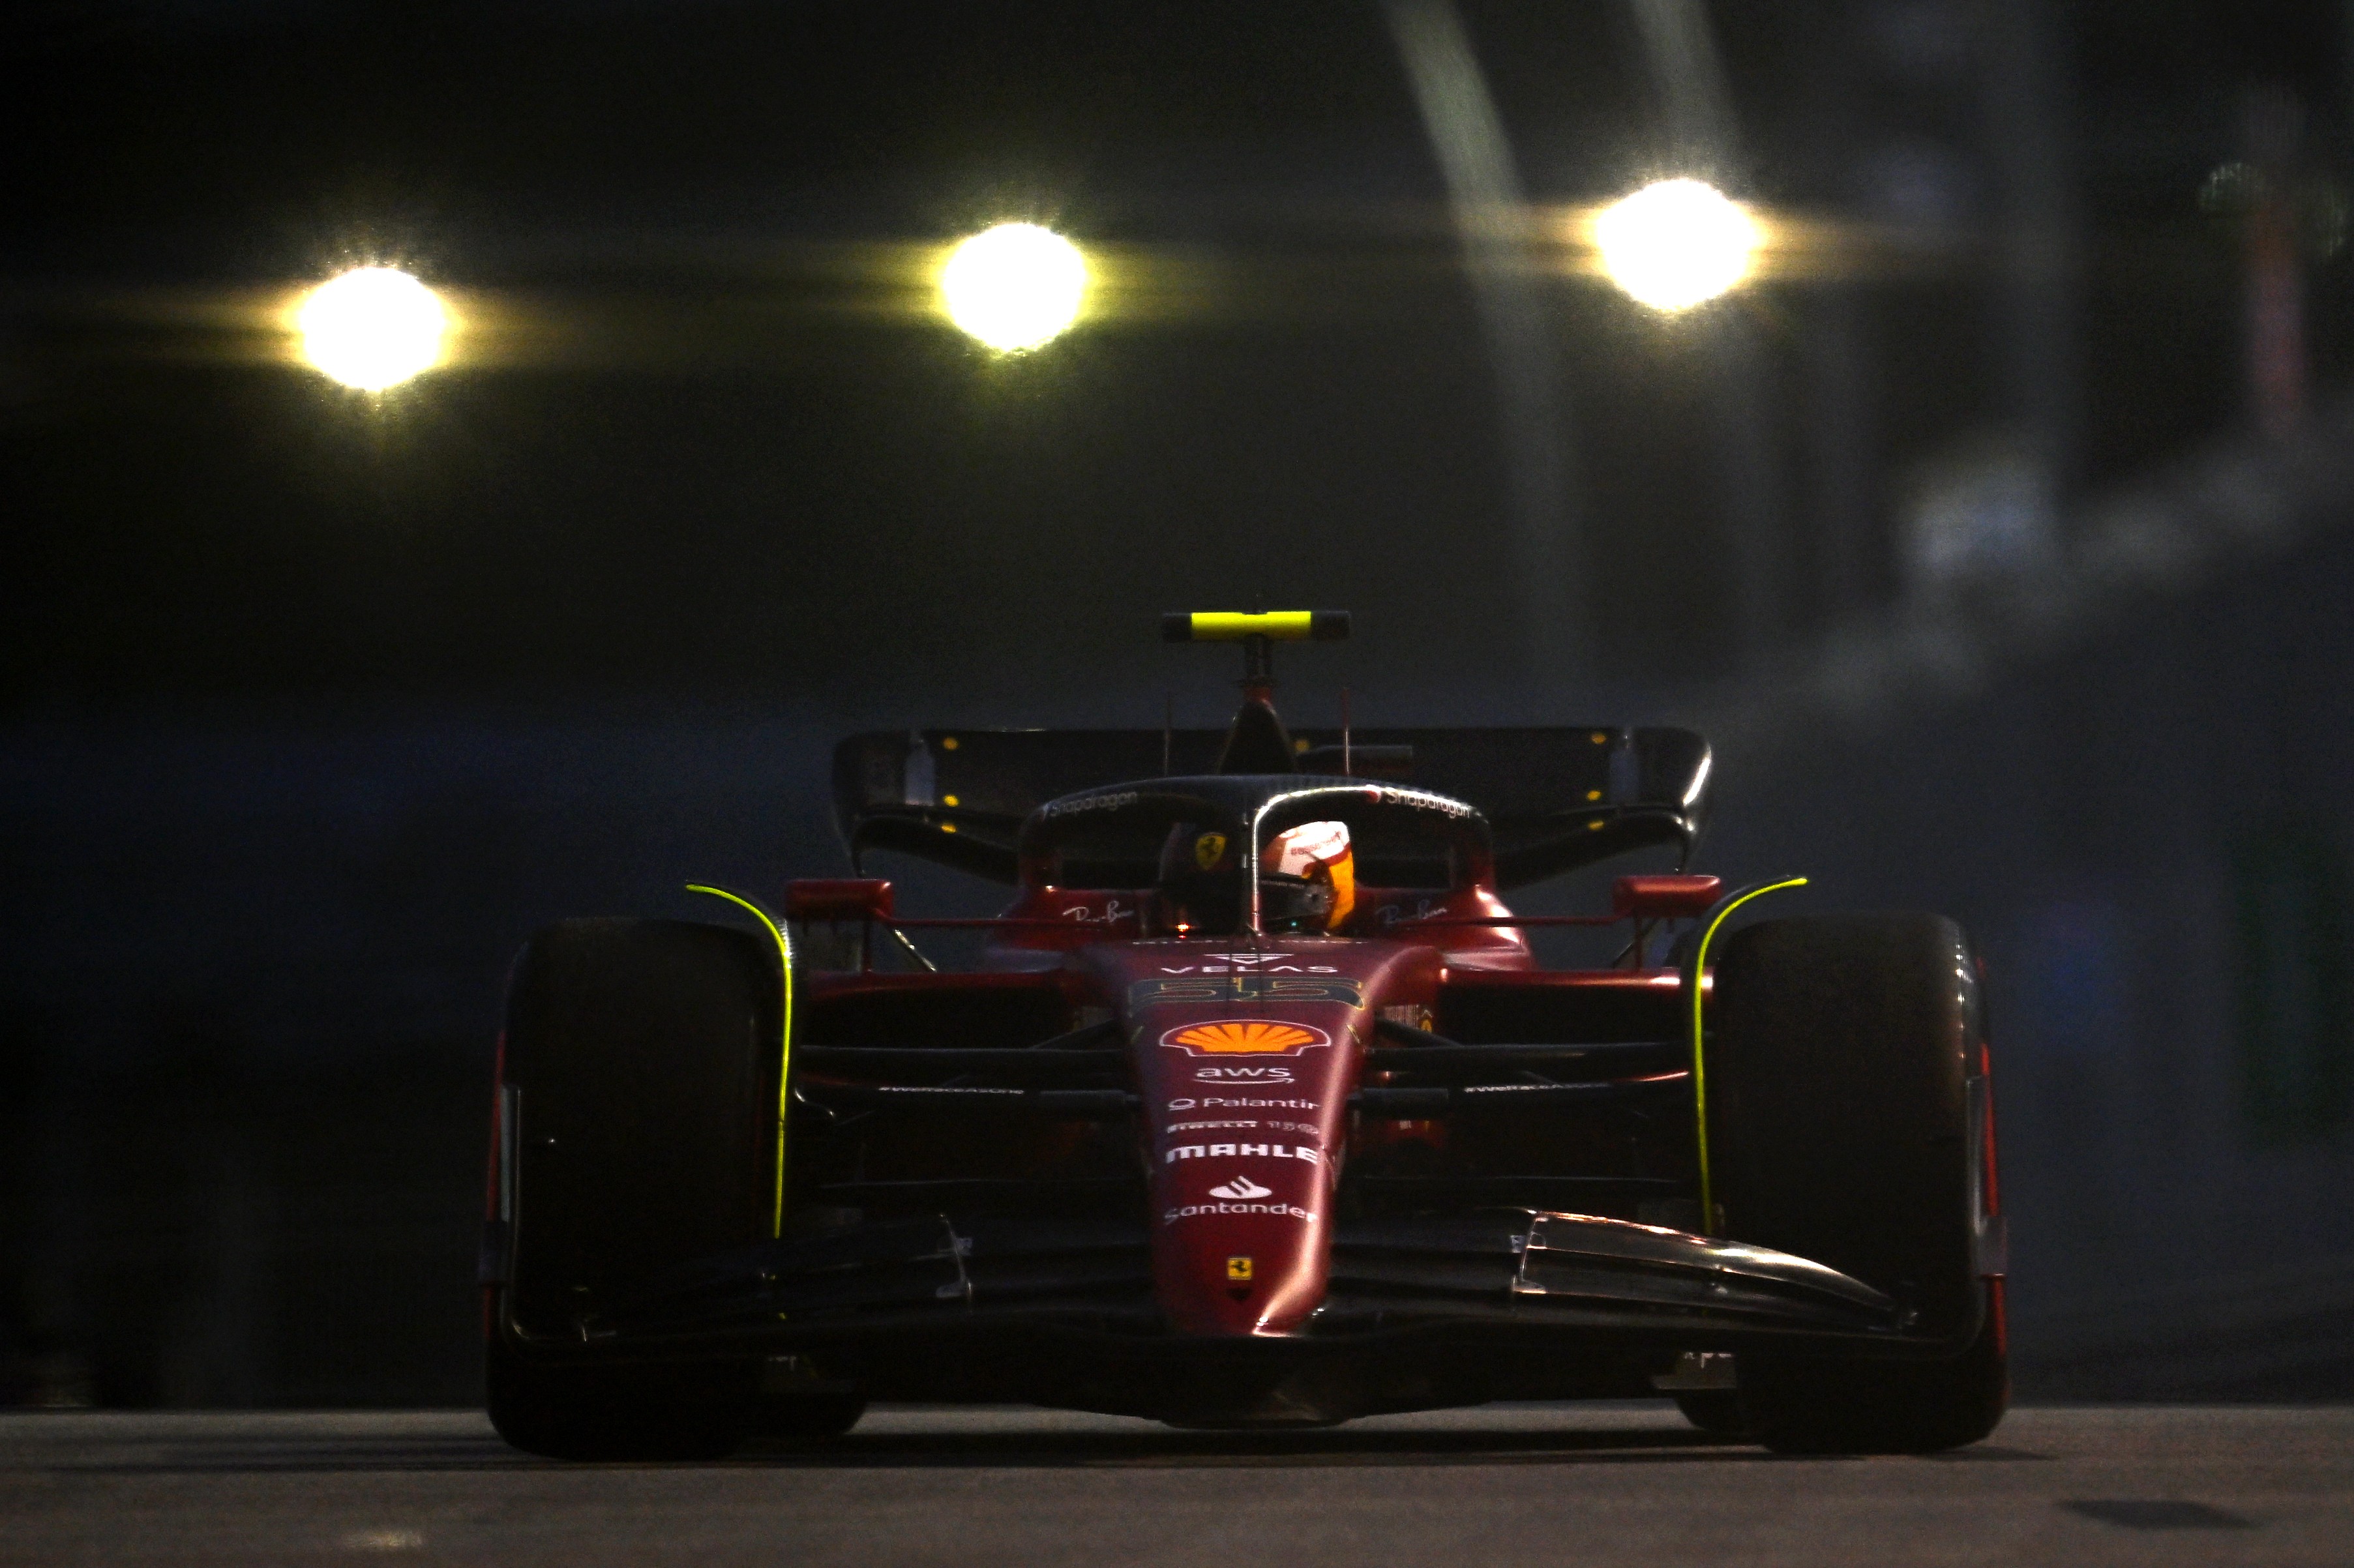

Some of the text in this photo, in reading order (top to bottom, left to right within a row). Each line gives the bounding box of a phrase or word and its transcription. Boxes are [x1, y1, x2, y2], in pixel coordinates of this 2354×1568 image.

[1388, 790, 1469, 819] Snapdragon
[1161, 965, 1338, 974] VELAS
[1195, 1067, 1291, 1078] aws
[1203, 1097, 1320, 1110] Palantir
[1165, 1143, 1319, 1165] MAHLE
